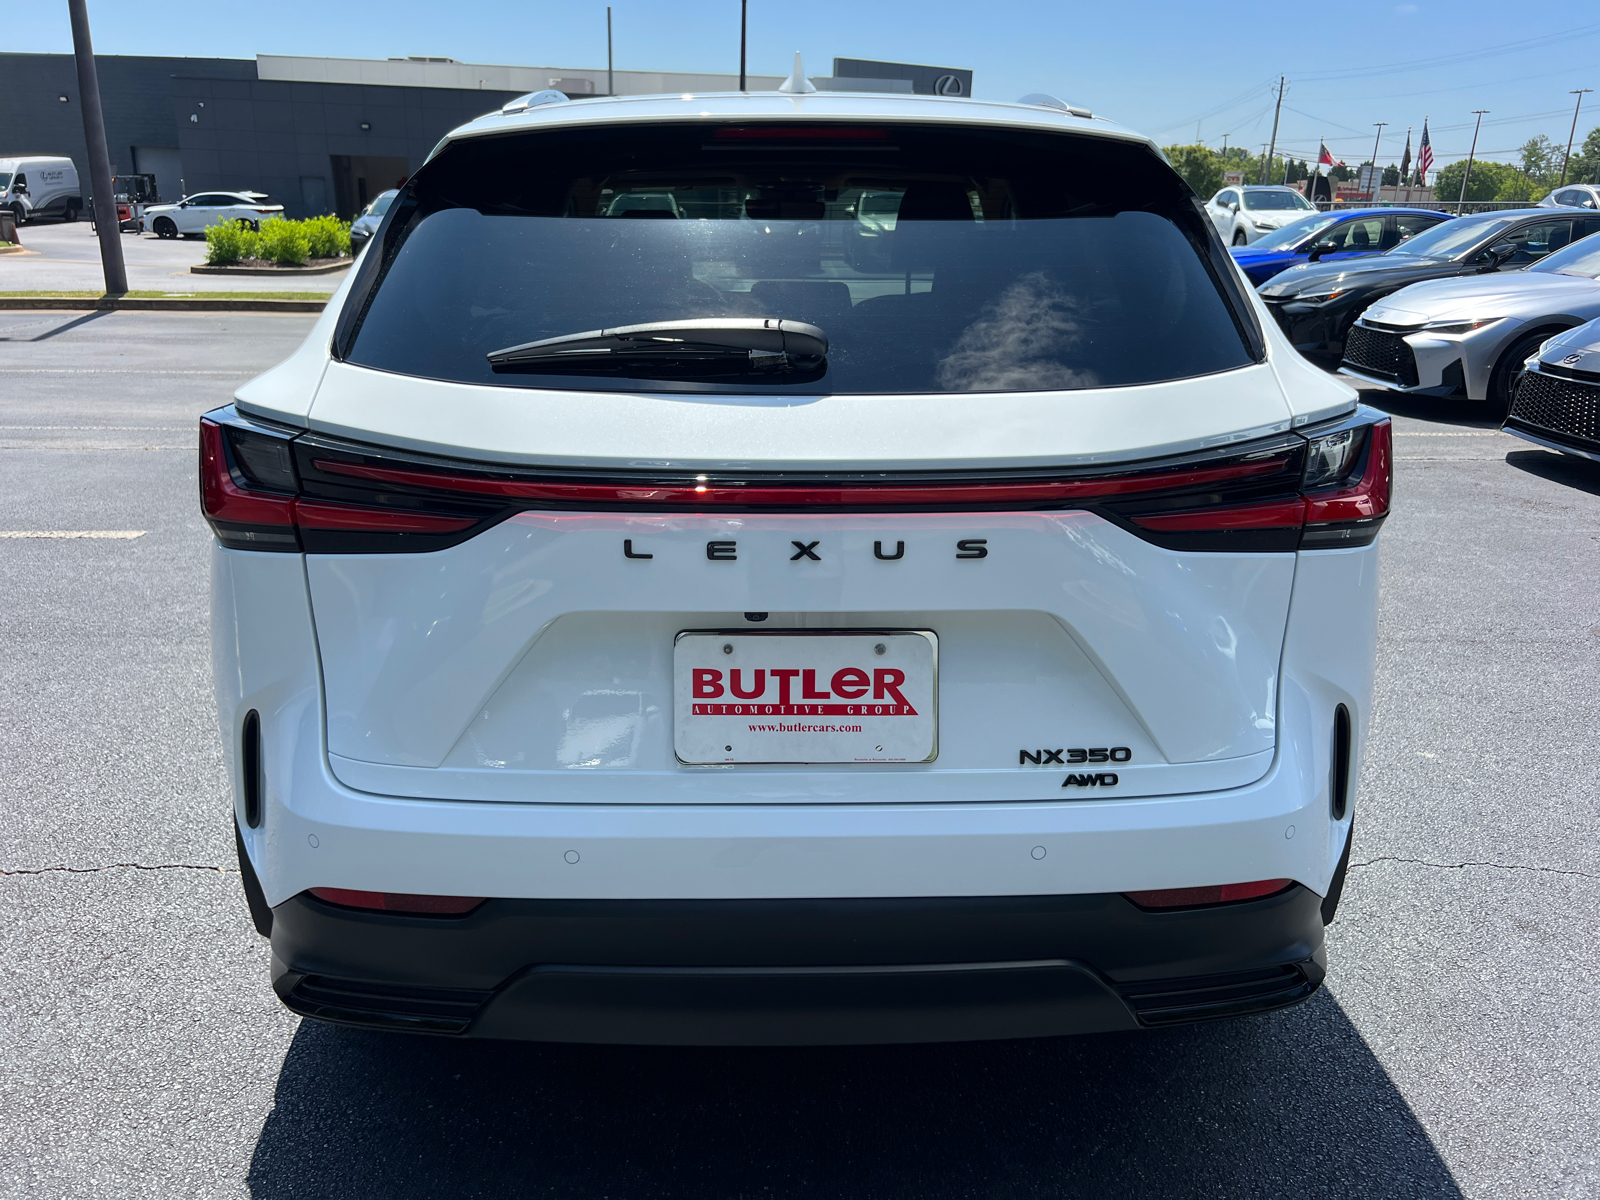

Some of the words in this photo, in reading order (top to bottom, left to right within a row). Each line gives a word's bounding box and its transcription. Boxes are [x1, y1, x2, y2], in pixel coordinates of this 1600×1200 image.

[623, 538, 988, 561] LEXUS
[693, 705, 824, 715] AUTOMOTIVE
[847, 705, 909, 715] GROUP
[748, 722, 862, 733] www.butlercars.com
[1019, 746, 1132, 765] NX350
[1061, 772, 1119, 788] AWD
